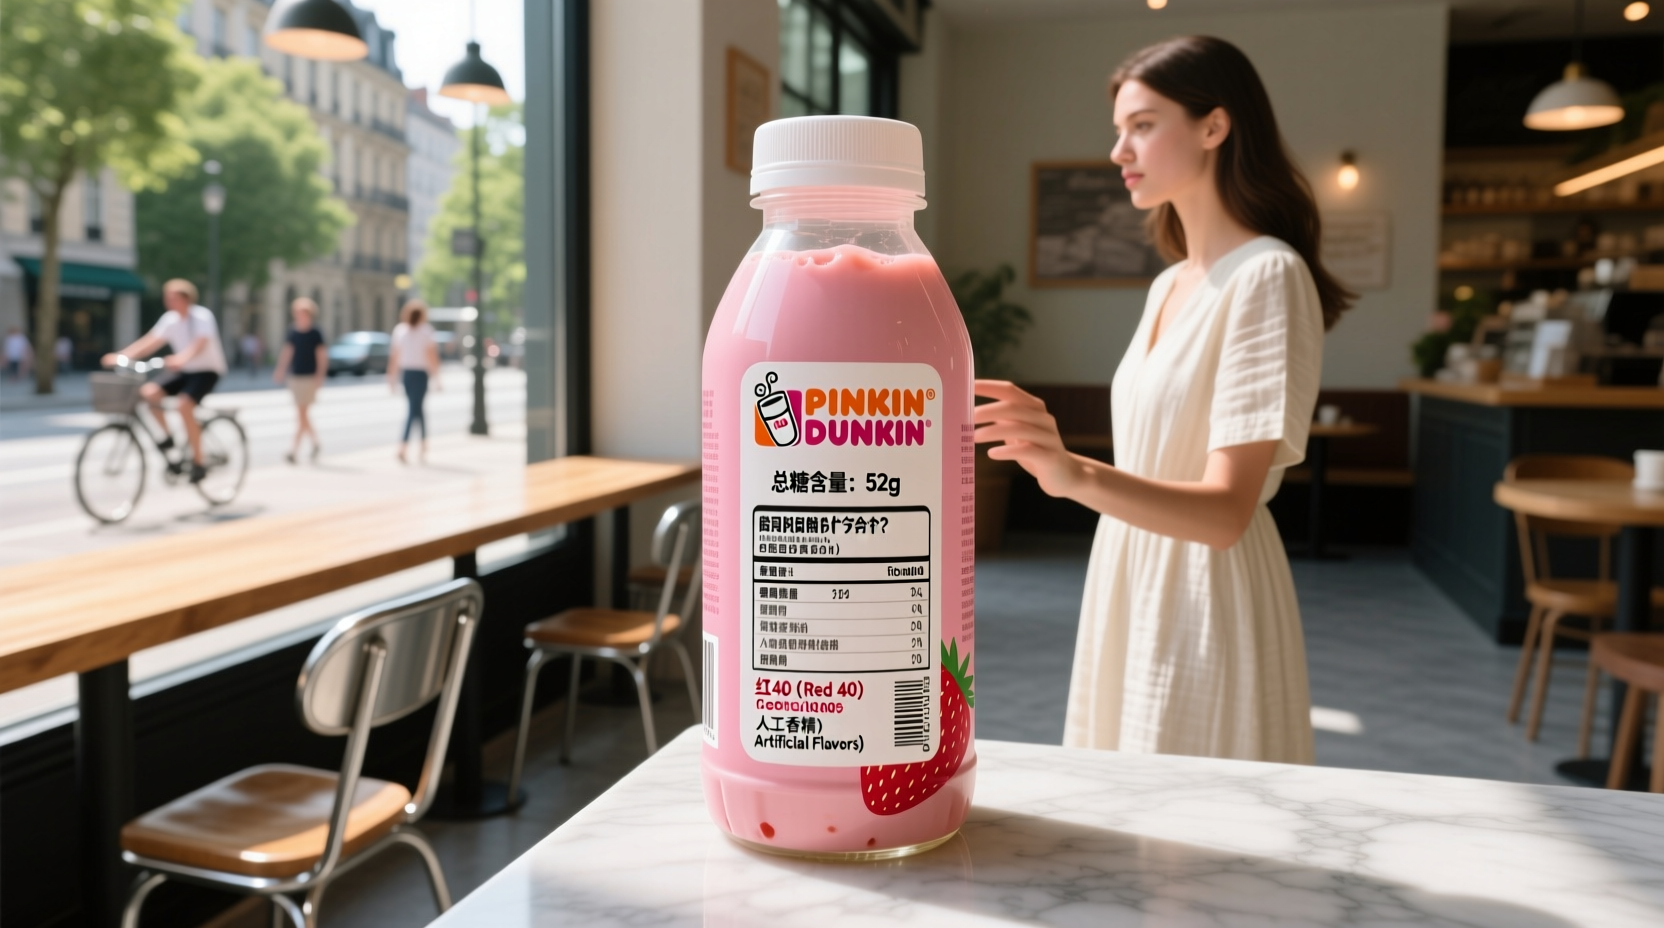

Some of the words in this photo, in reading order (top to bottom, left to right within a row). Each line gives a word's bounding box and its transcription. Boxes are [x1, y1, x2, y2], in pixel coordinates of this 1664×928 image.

[805, 419, 925, 446] DUNKIN
[796, 680, 833, 699] (Red
[837, 680, 864, 700] 40)
[812, 735, 864, 753] Flavors)
